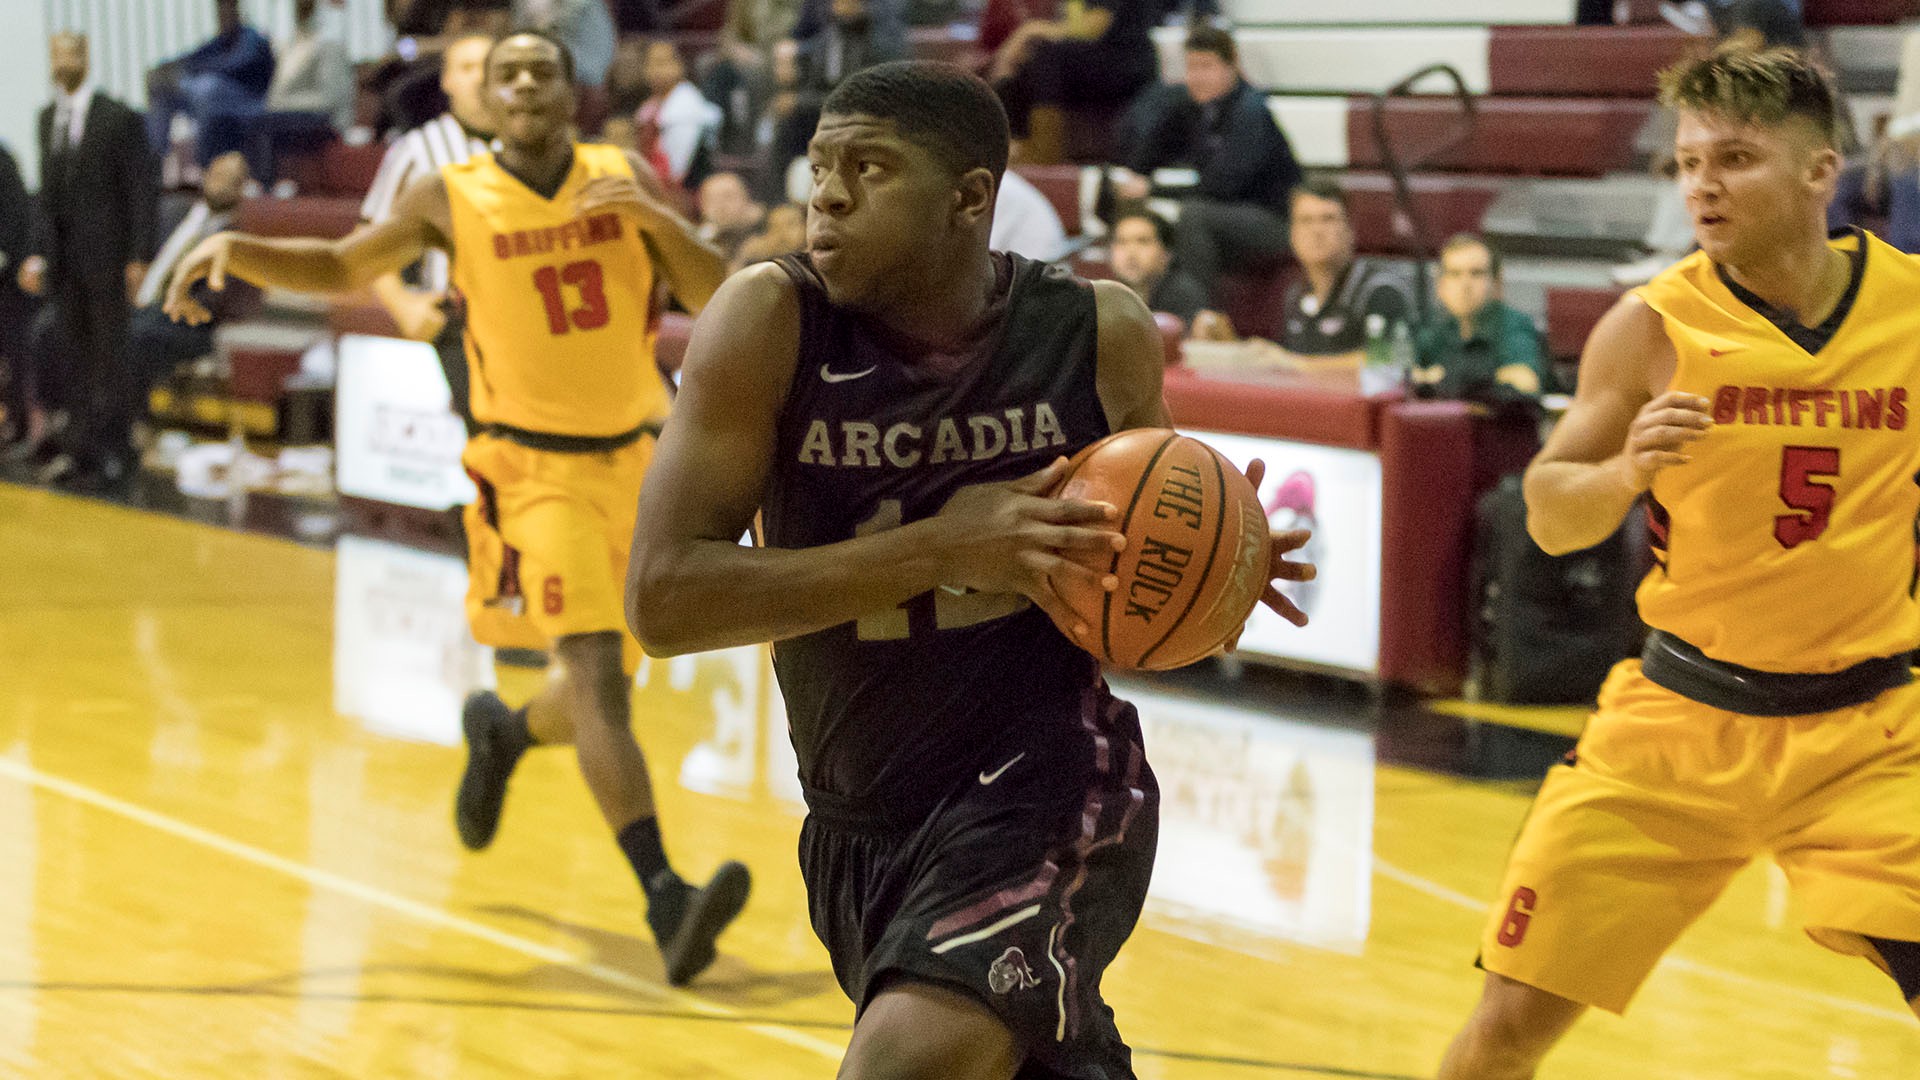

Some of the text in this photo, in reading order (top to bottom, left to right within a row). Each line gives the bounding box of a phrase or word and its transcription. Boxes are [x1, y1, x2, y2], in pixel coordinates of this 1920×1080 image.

[533, 258, 611, 335] 13
[798, 402, 1067, 469] ARCADIA
[1713, 385, 1908, 430] GRIFFINS
[1774, 445, 1840, 550] 5
[1124, 465, 1204, 625] THE ROCK
